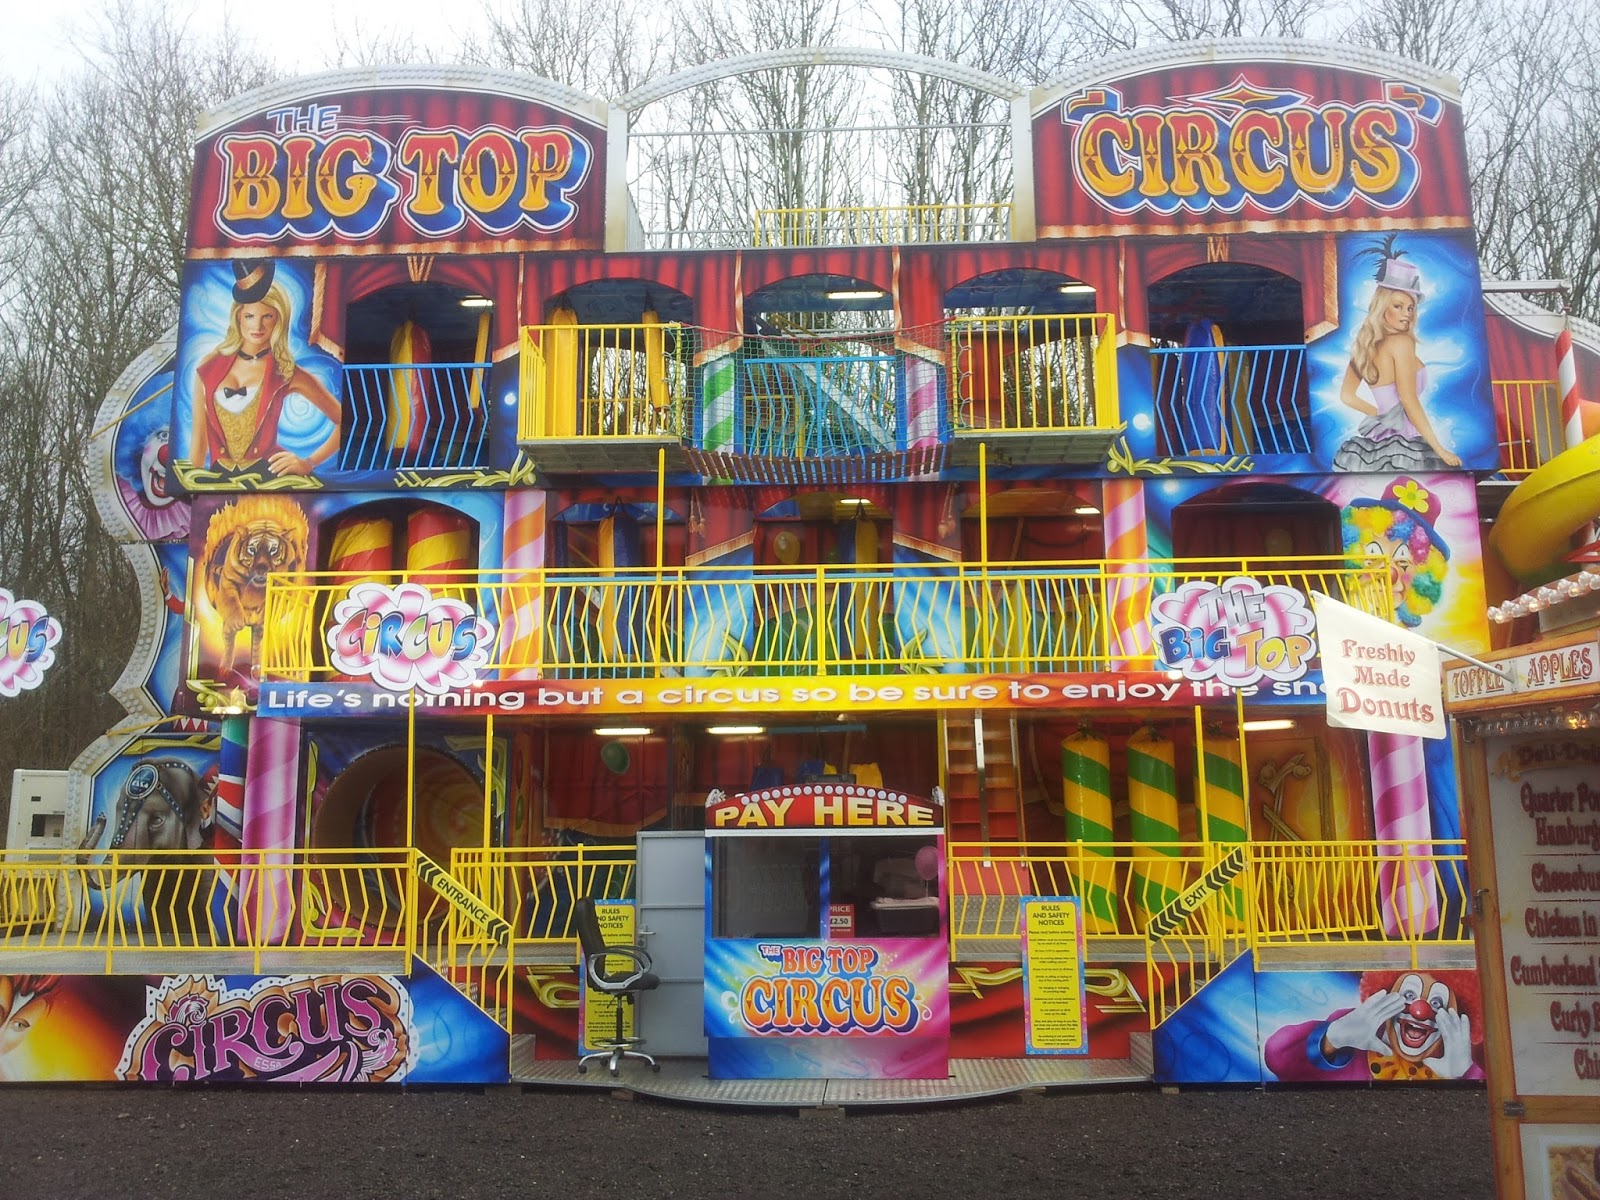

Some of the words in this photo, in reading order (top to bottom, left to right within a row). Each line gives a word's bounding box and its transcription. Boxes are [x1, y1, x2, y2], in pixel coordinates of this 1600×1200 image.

[267, 104, 341, 135] THE
[1077, 107, 1409, 206] CIRCUS
[218, 133, 388, 229] BIG
[402, 130, 585, 227] TOP
[1197, 586, 1267, 627] THE
[1237, 633, 1313, 671] TOP
[1341, 639, 1416, 667] Freshly
[1354, 666, 1411, 690] Made
[1452, 663, 1505, 698] TOFFEE
[1527, 647, 1593, 688] APPLES
[268, 689, 362, 709] Life's
[538, 686, 603, 706] but
[616, 688, 643, 704] a
[657, 685, 780, 704] circus
[791, 687, 837, 702] so
[849, 684, 904, 702] be
[913, 684, 998, 702] sure
[1009, 680, 1048, 700] to
[1062, 680, 1179, 701] enjoy
[1336, 686, 1435, 724] Donuts
[715, 797, 795, 827] PAY
[814, 796, 934, 827] HERE
[1521, 782, 1575, 818] Quarter
[436, 877, 490, 924] ENTRANCE
[1184, 884, 1208, 908] EXIT
[1525, 907, 1581, 937] Chicken
[1582, 910, 1598, 937] in
[761, 945, 781, 956] THE
[782, 947, 824, 974] BIG
[827, 946, 876, 974] TOP
[1510, 955, 1598, 987] Cumberland
[742, 976, 914, 1030] CIRCUS
[1550, 1000, 1591, 1039] Curly
[142, 978, 390, 1082] CIRCUS
